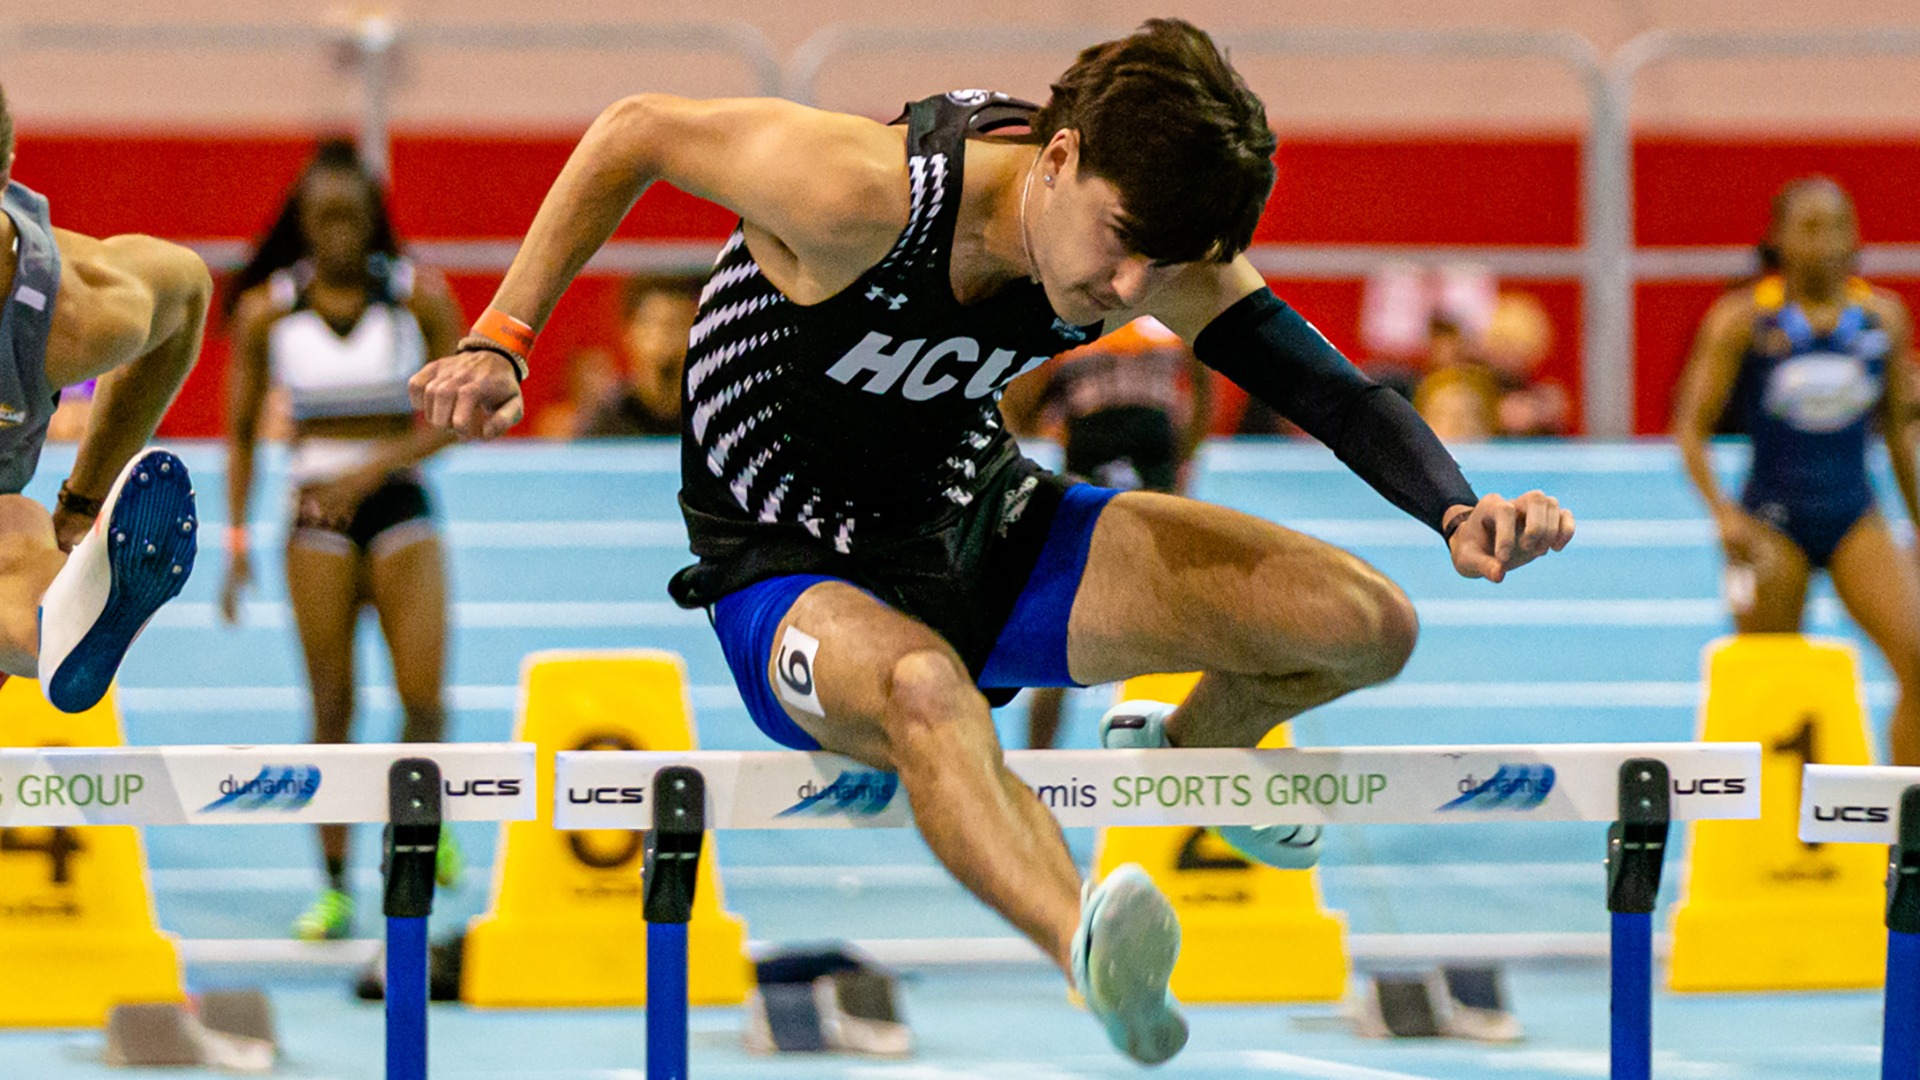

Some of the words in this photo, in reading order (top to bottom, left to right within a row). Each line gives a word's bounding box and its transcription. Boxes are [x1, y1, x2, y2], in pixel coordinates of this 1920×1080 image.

[825, 330, 1051, 401] HCU
[18, 773, 144, 807] GROUP
[219, 773, 315, 796] dunamis
[445, 779, 521, 796] UCS
[1112, 775, 1252, 808] SPORTS
[1266, 773, 1387, 805] GROUP
[1674, 778, 1746, 795] UCS
[569, 787, 645, 804] UCS
[1814, 806, 1890, 823] UCS
